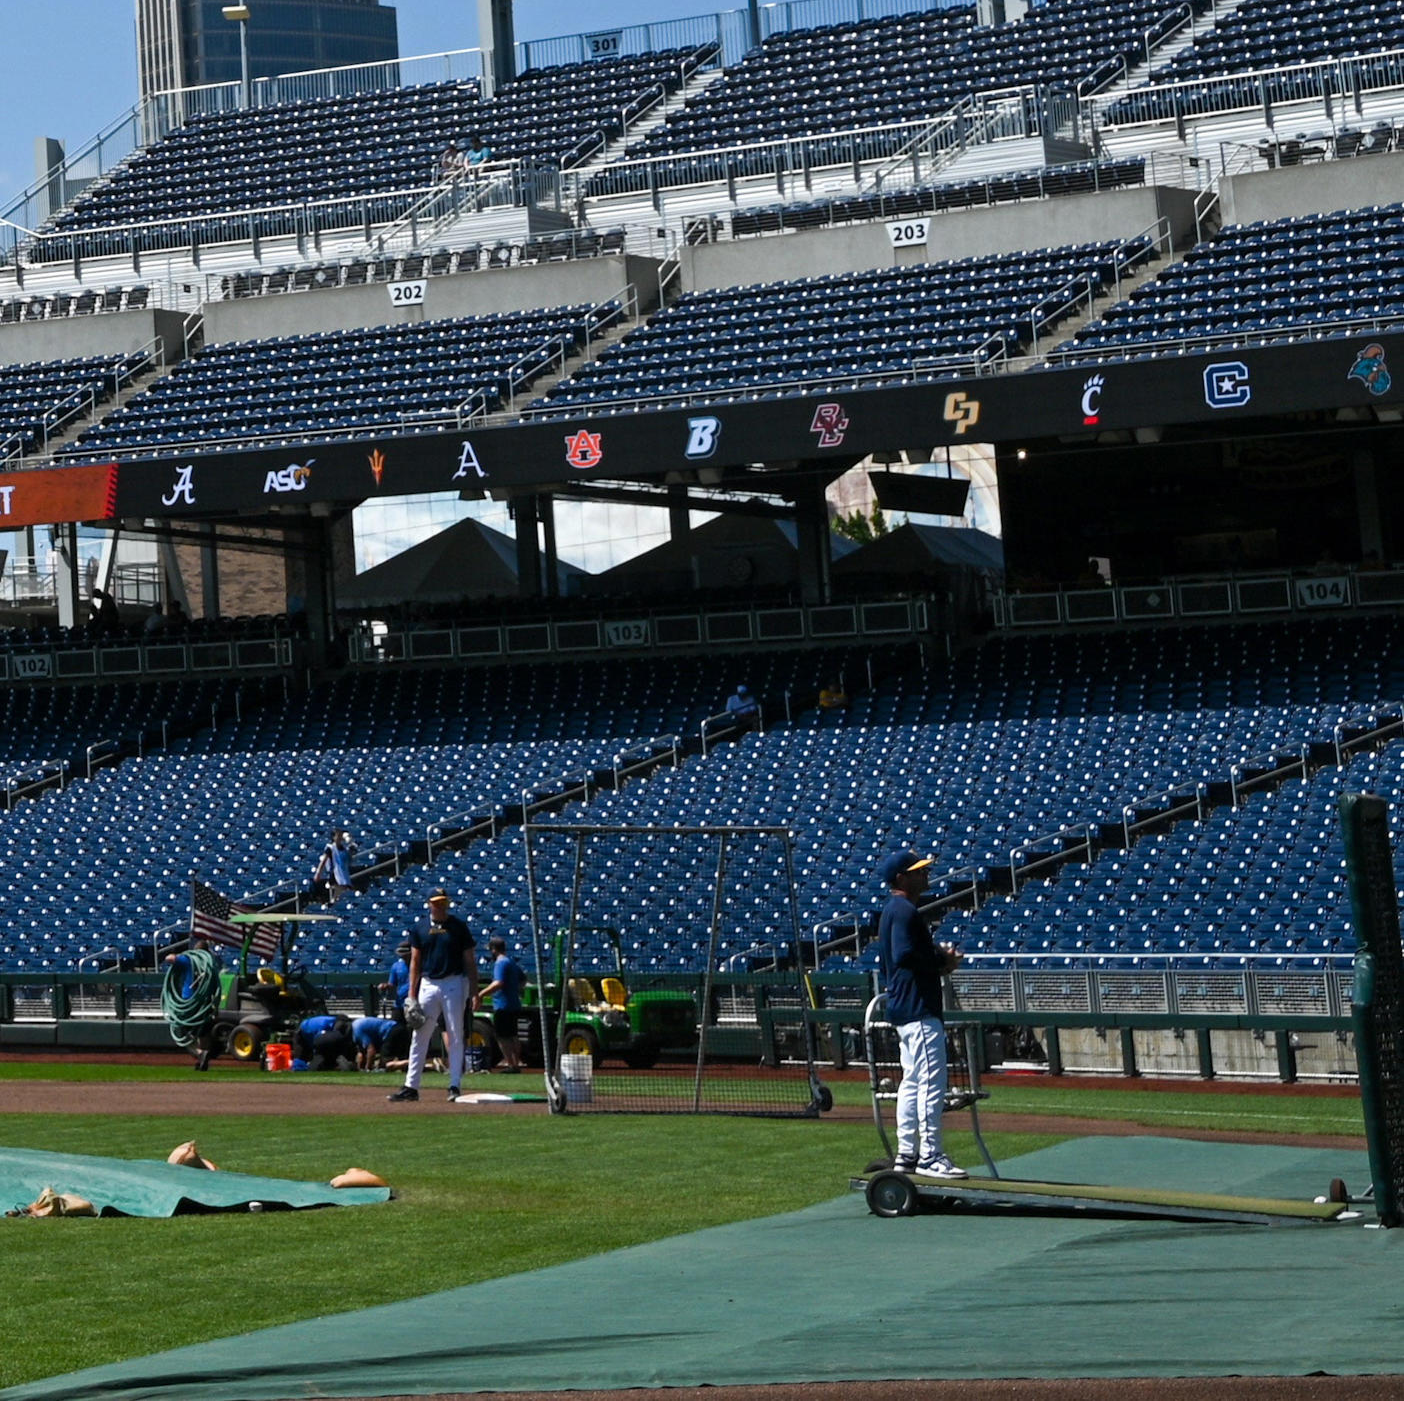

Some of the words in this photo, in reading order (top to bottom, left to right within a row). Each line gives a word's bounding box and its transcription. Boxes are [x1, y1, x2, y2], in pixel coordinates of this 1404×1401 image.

[591, 36, 618, 53] 301
[893, 224, 926, 241] 203
[392, 285, 423, 301] 202
[1305, 582, 1342, 601] 104
[610, 622, 643, 641] 103
[19, 659, 47, 674] 102
